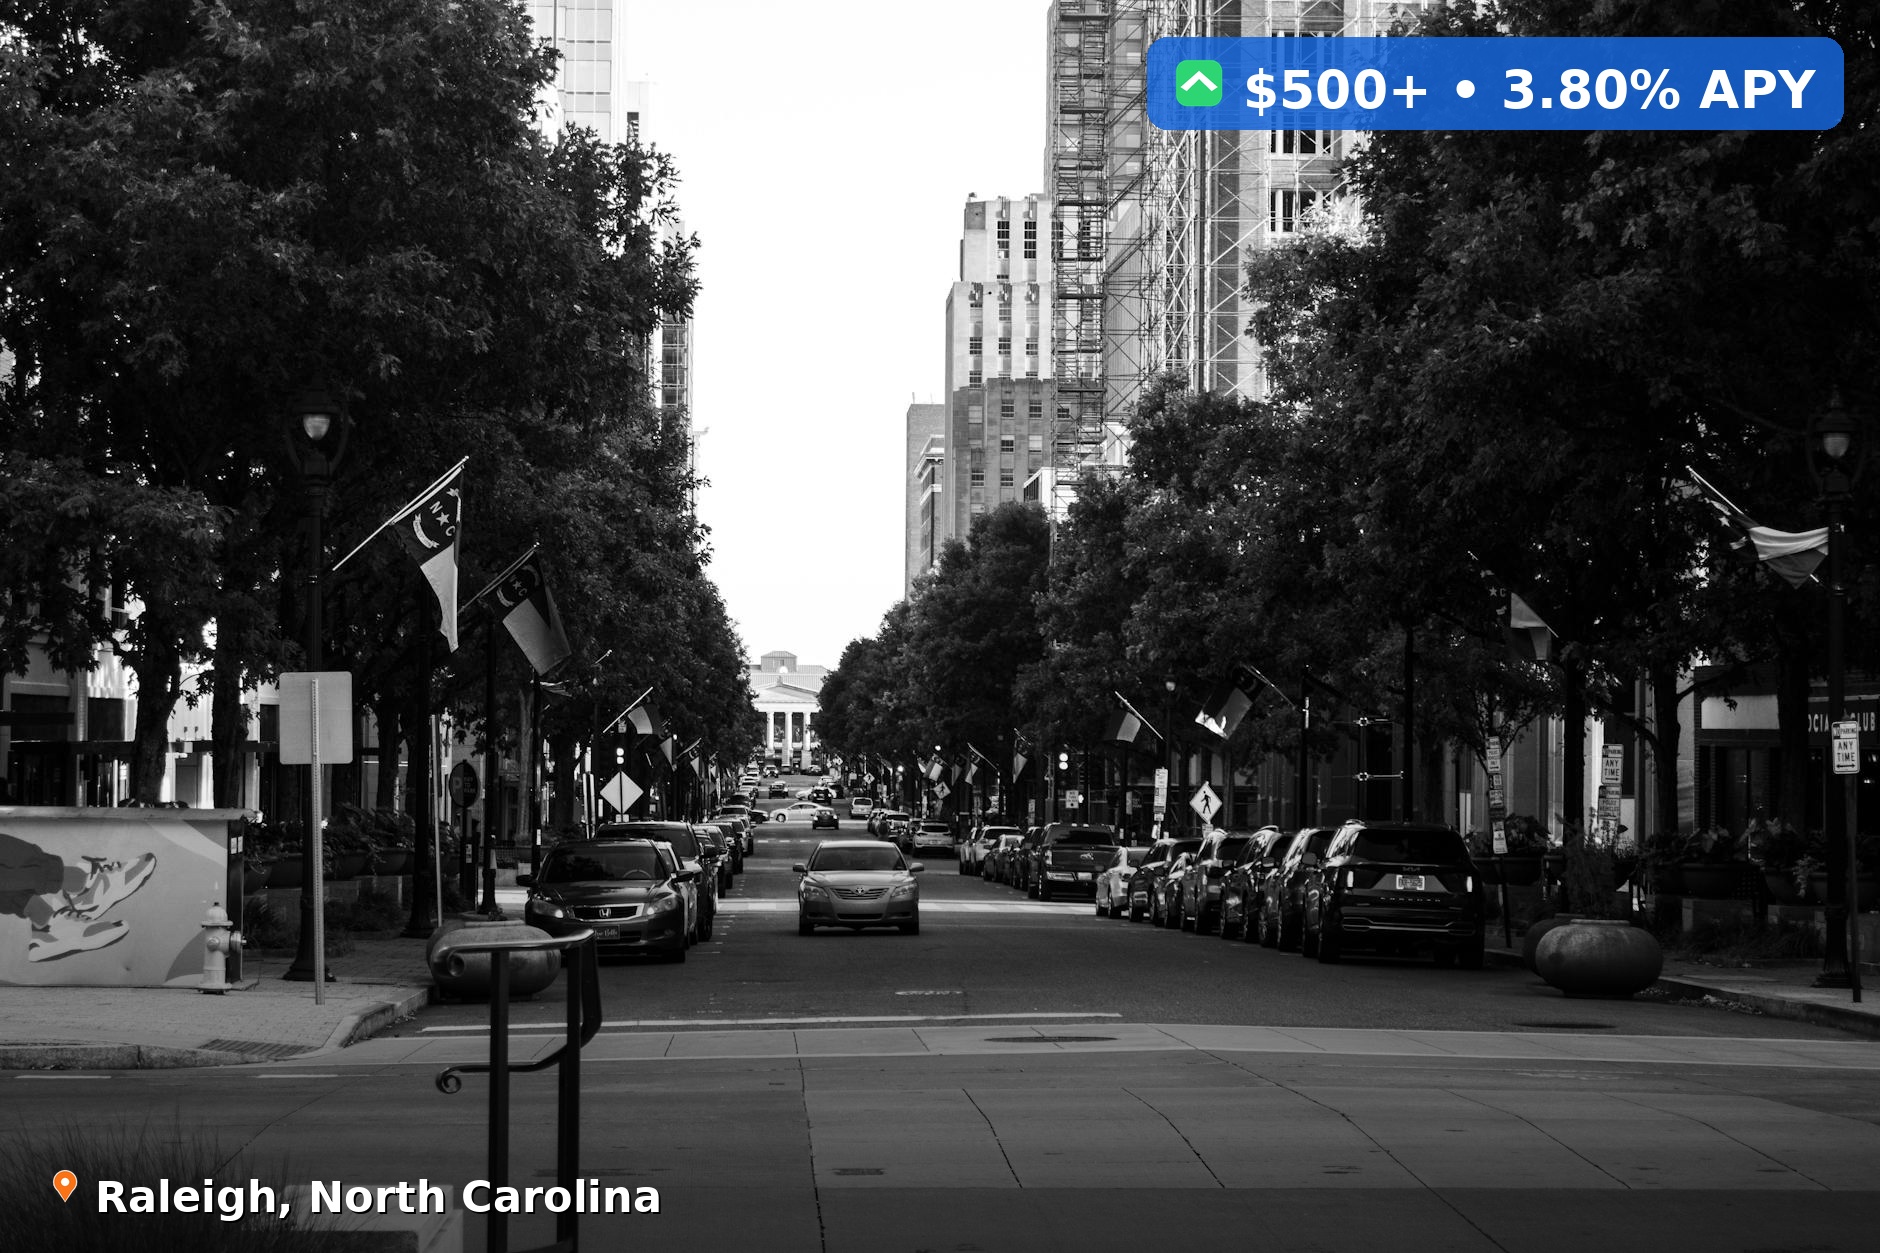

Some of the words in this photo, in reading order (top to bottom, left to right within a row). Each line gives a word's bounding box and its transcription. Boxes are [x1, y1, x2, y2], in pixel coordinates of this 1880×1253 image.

[1807, 713, 1830, 733] OCIA
[1838, 741, 1854, 751] ANY
[1836, 752, 1856, 762] TIME
[1605, 759, 1619, 768] ANY
[1604, 768, 1620, 777] TIME
